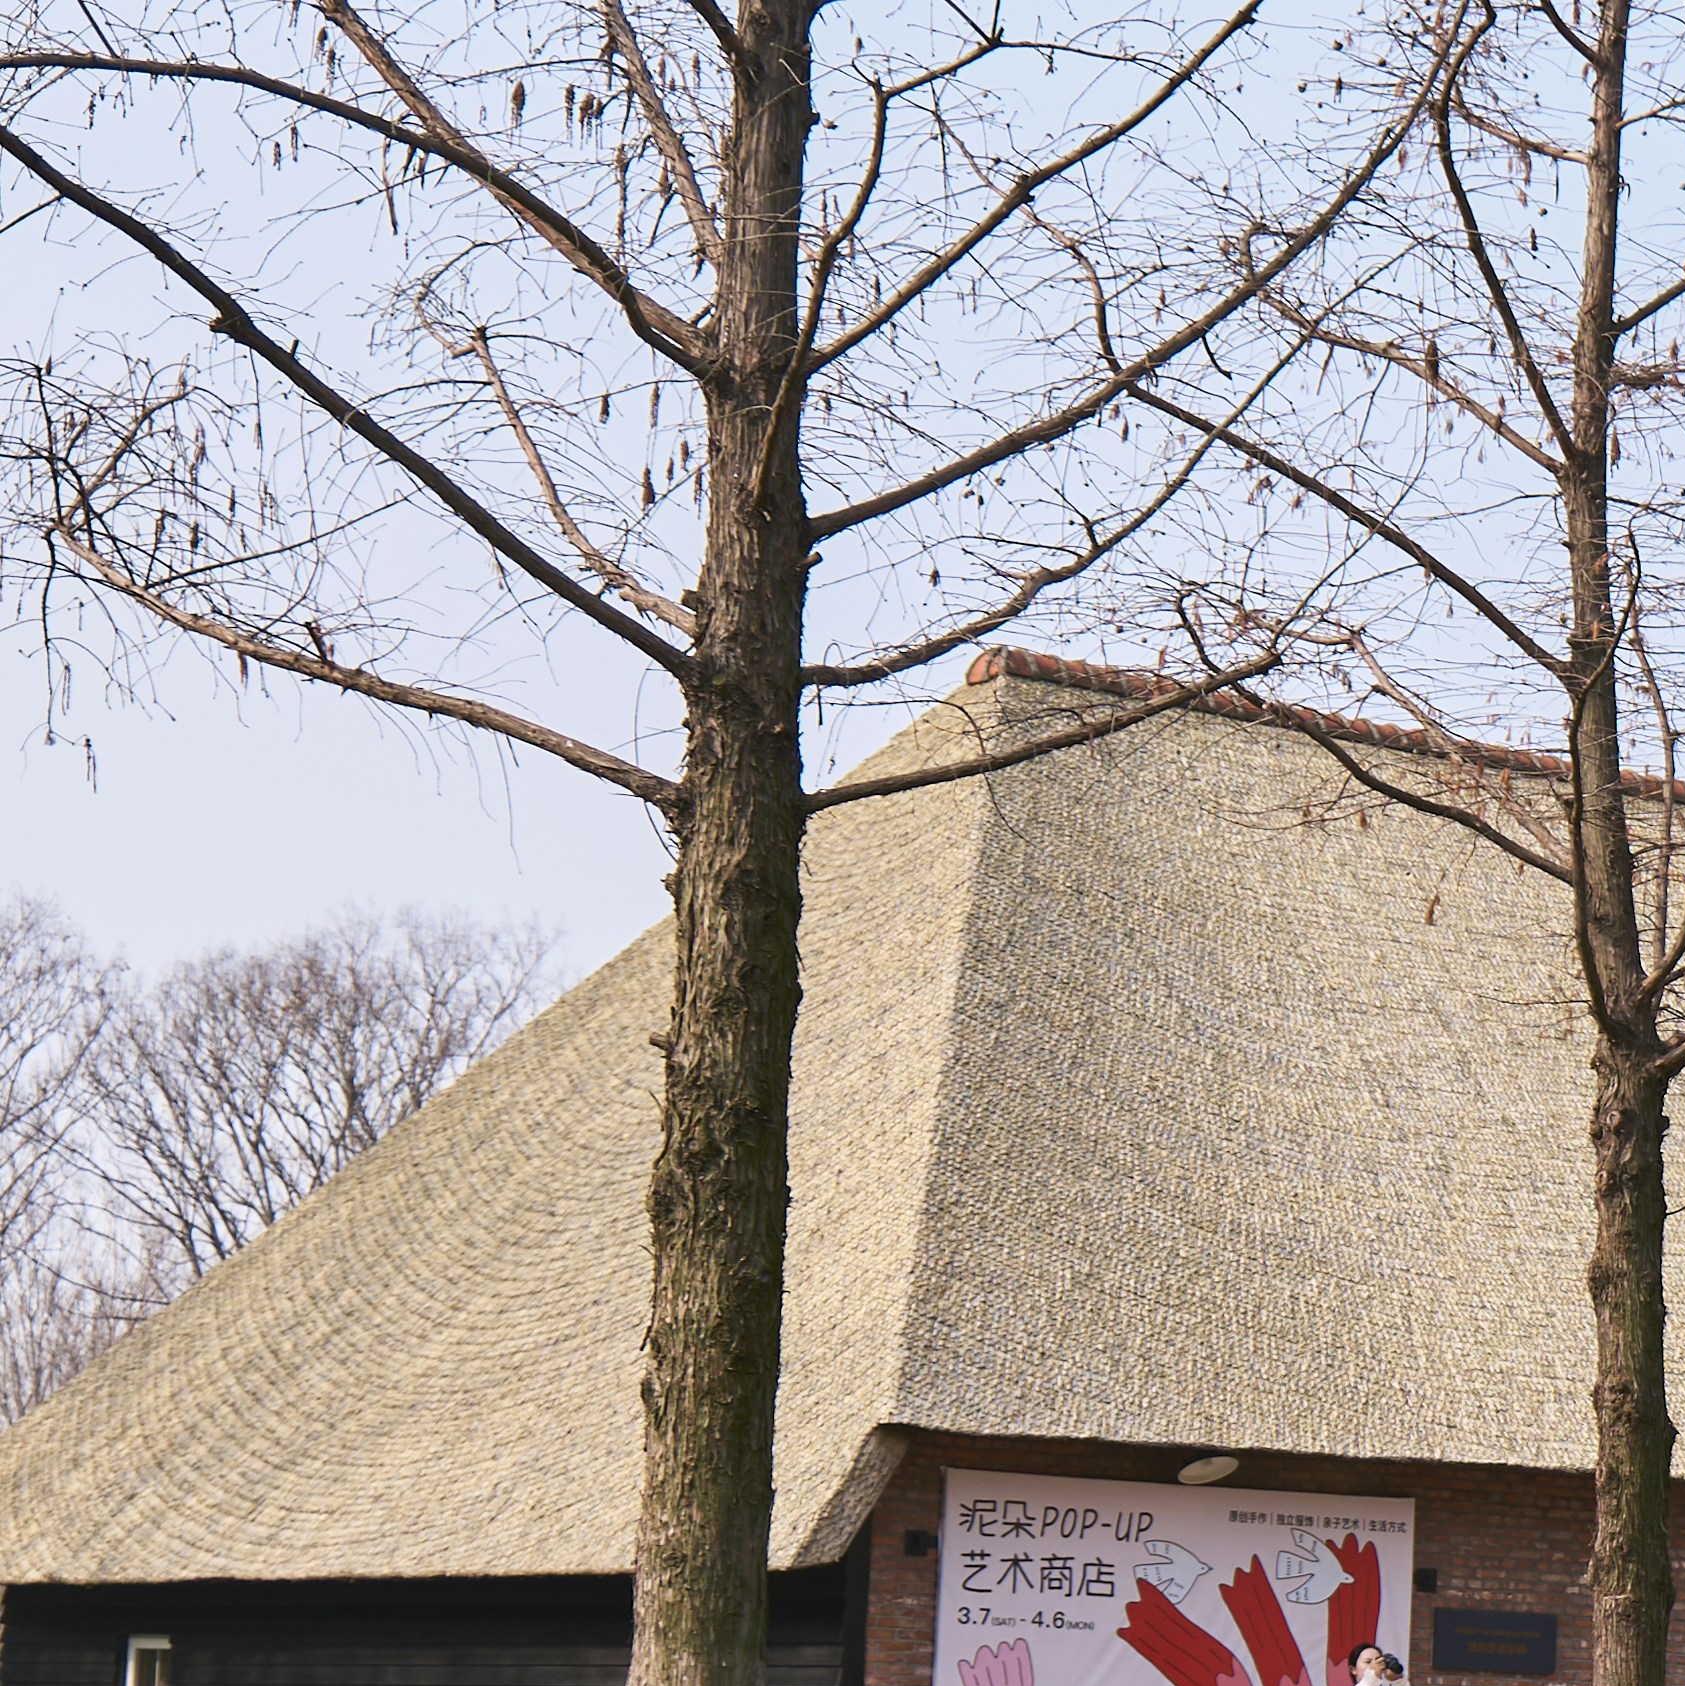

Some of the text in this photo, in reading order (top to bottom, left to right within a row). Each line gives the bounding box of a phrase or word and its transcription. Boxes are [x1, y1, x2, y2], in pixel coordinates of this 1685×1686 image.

[1228, 1510, 1407, 1534] 原创手作 独立服饰 亲子艺术 生活方式
[960, 1549, 1116, 1597] 艺术商店
